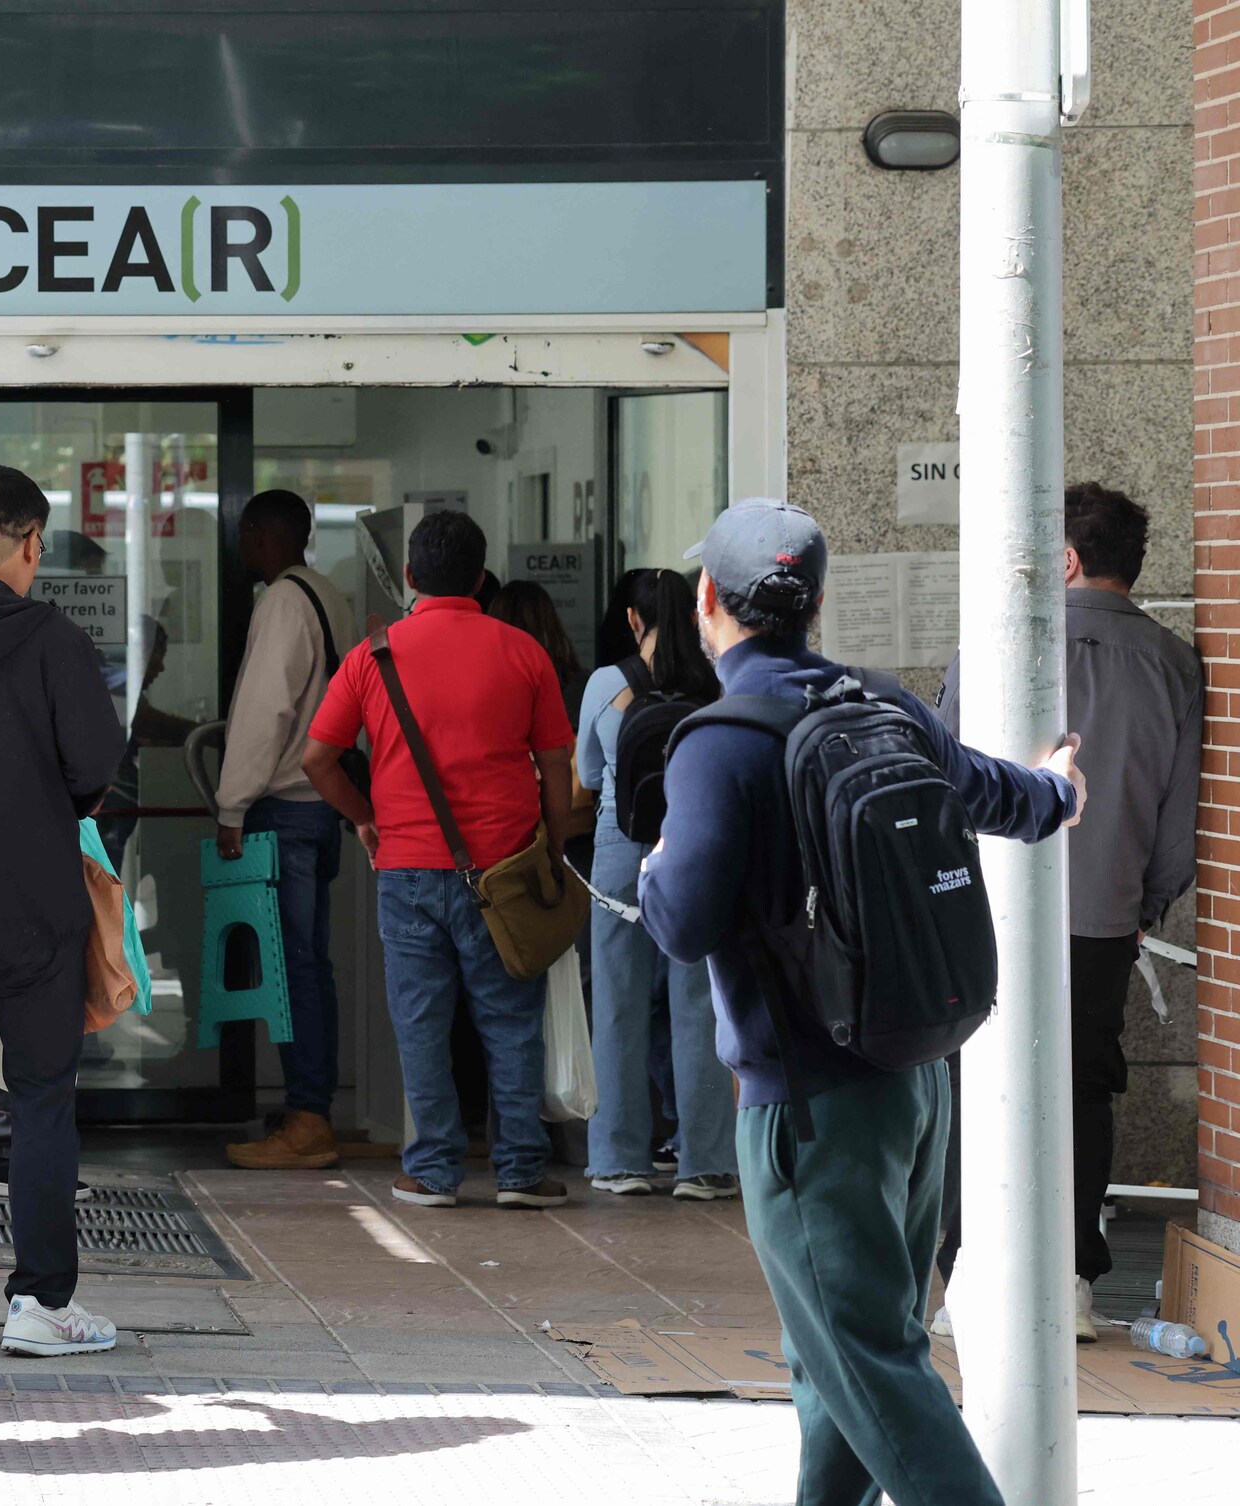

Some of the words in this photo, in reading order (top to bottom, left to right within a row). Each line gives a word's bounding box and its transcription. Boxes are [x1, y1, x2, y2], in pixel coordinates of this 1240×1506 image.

[911, 463, 946, 481] SIN
[42, 582, 69, 595] Por
[74, 581, 114, 595] favor
[102, 602, 116, 616] la
[929, 875, 972, 895] mazars
